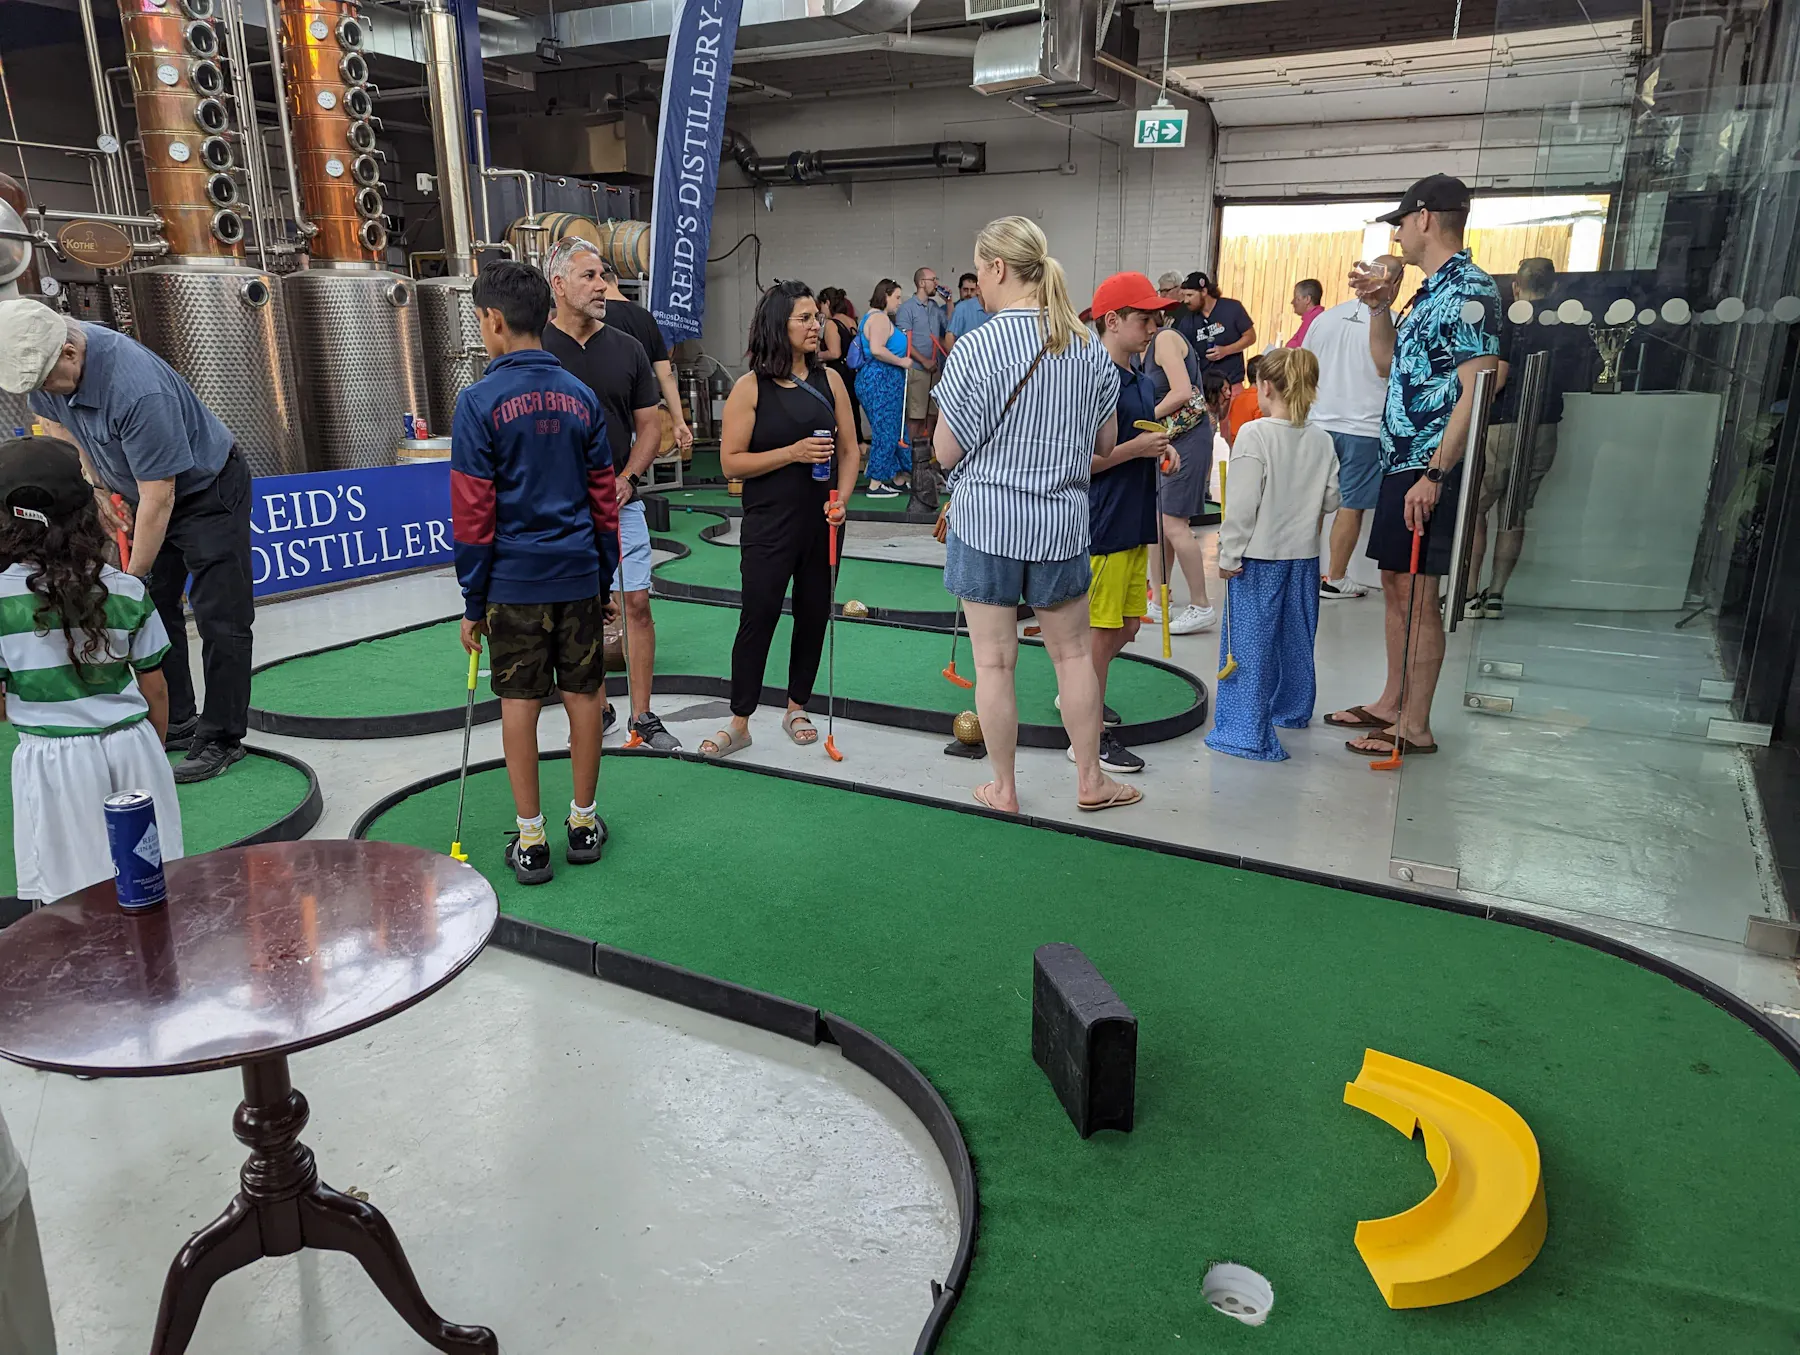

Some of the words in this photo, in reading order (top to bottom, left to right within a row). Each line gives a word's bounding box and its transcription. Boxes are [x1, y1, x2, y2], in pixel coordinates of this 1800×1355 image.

[678, 5, 723, 209] DISTILLERY
[66, 239, 95, 250] KOTHE
[669, 214, 698, 312] REID'S
[251, 518, 453, 585] DISTILLER
